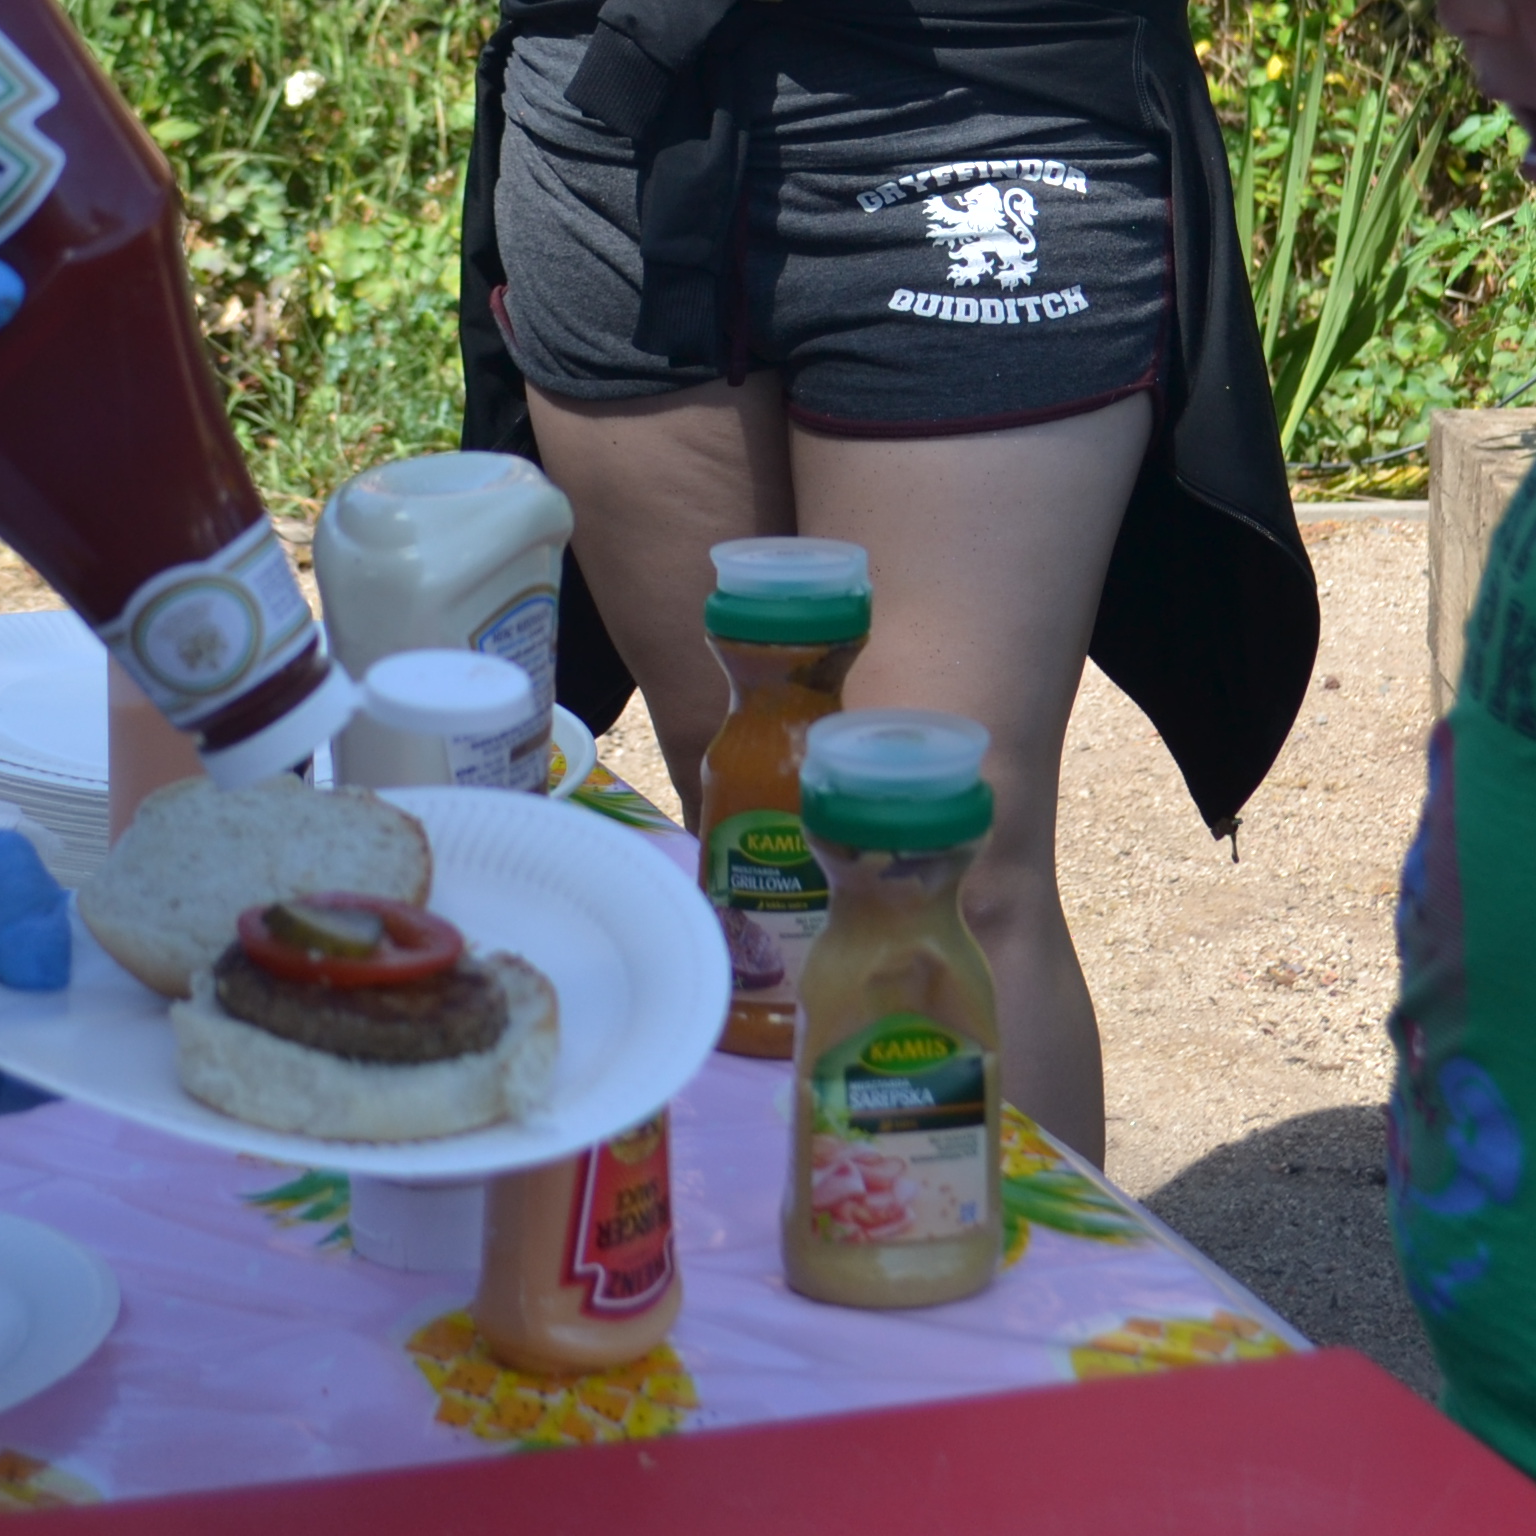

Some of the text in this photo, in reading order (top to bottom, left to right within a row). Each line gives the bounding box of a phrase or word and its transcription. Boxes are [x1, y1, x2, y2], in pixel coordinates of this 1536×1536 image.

[856, 159, 1088, 213] GRYFFINDOR
[887, 285, 1089, 325] QUIDDITCH
[746, 830, 808, 853] KAMI
[730, 872, 803, 892] GRILLOWA
[869, 1037, 950, 1061] KAMIS
